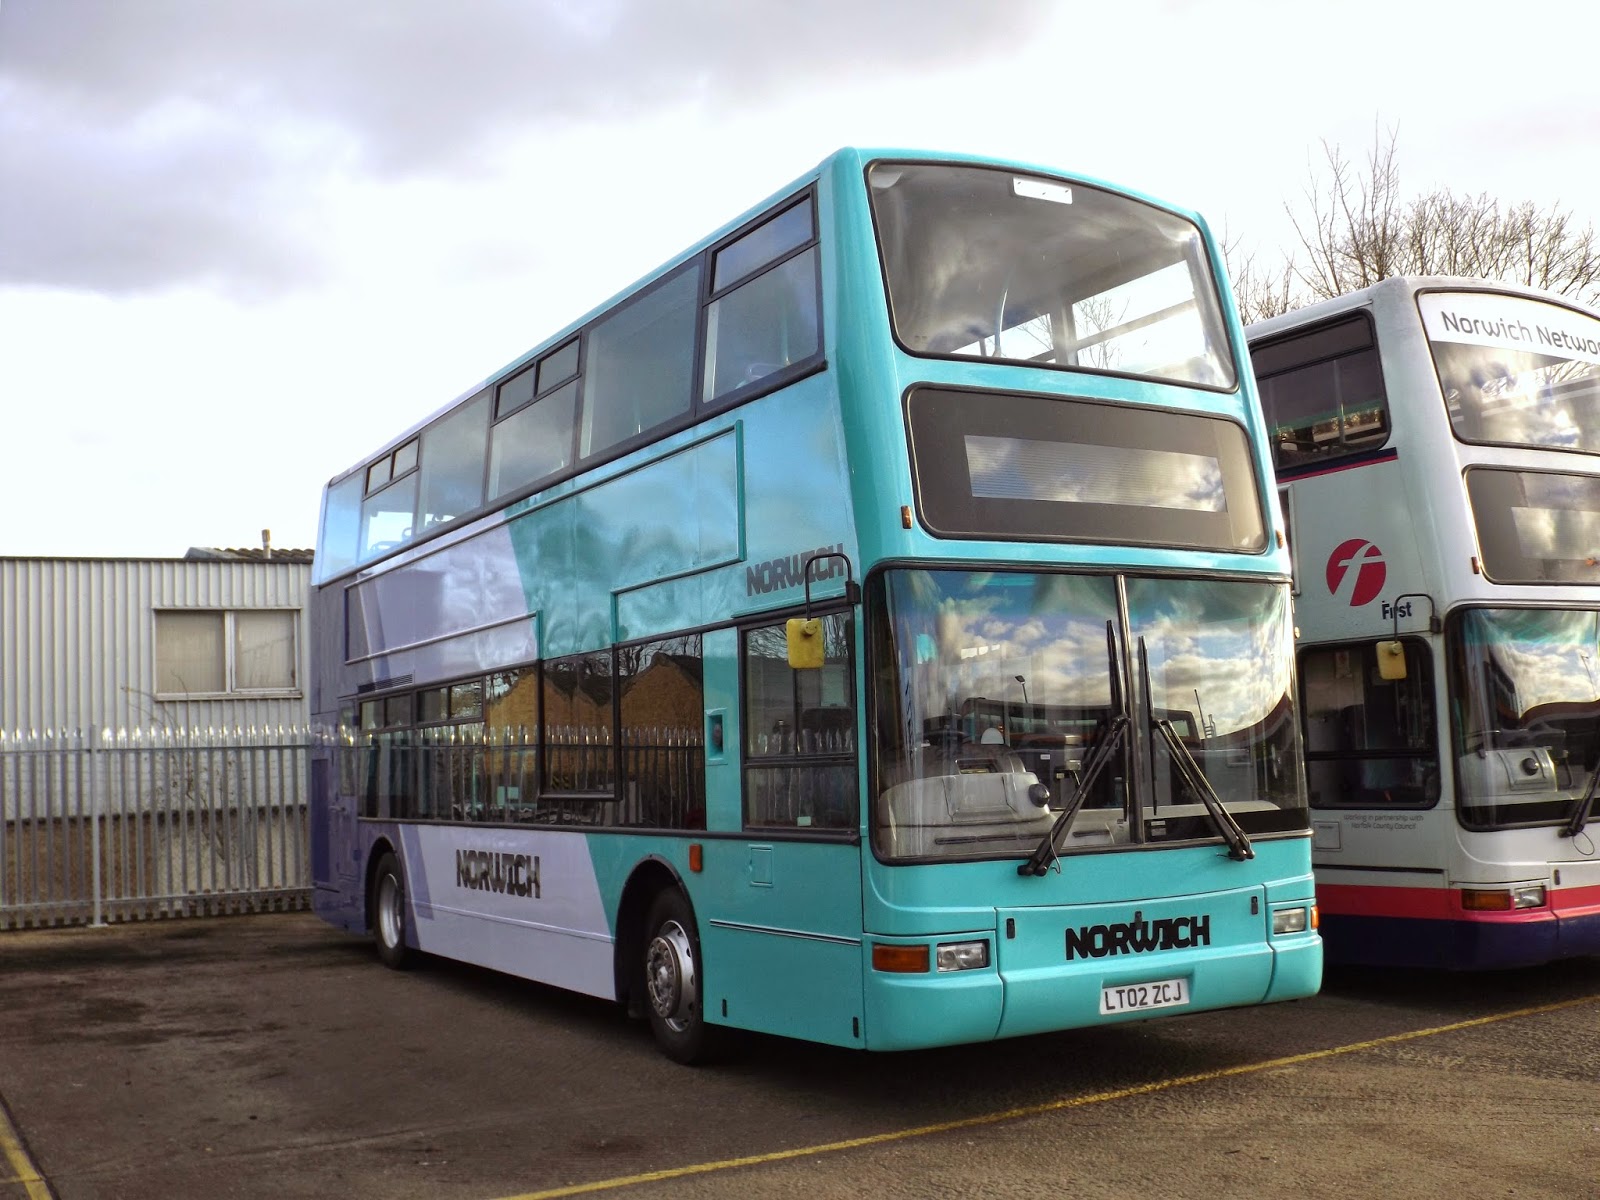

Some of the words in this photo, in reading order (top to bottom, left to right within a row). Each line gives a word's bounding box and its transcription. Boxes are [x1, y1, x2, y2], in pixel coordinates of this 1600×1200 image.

[1441, 310, 1533, 343] Norwich
[746, 543, 844, 597] NORWICH
[1372, 823, 1393, 831] County
[456, 849, 541, 899] NORWICH
[1065, 915, 1210, 961] NORWICH
[1152, 982, 1182, 1004] ZCJ
